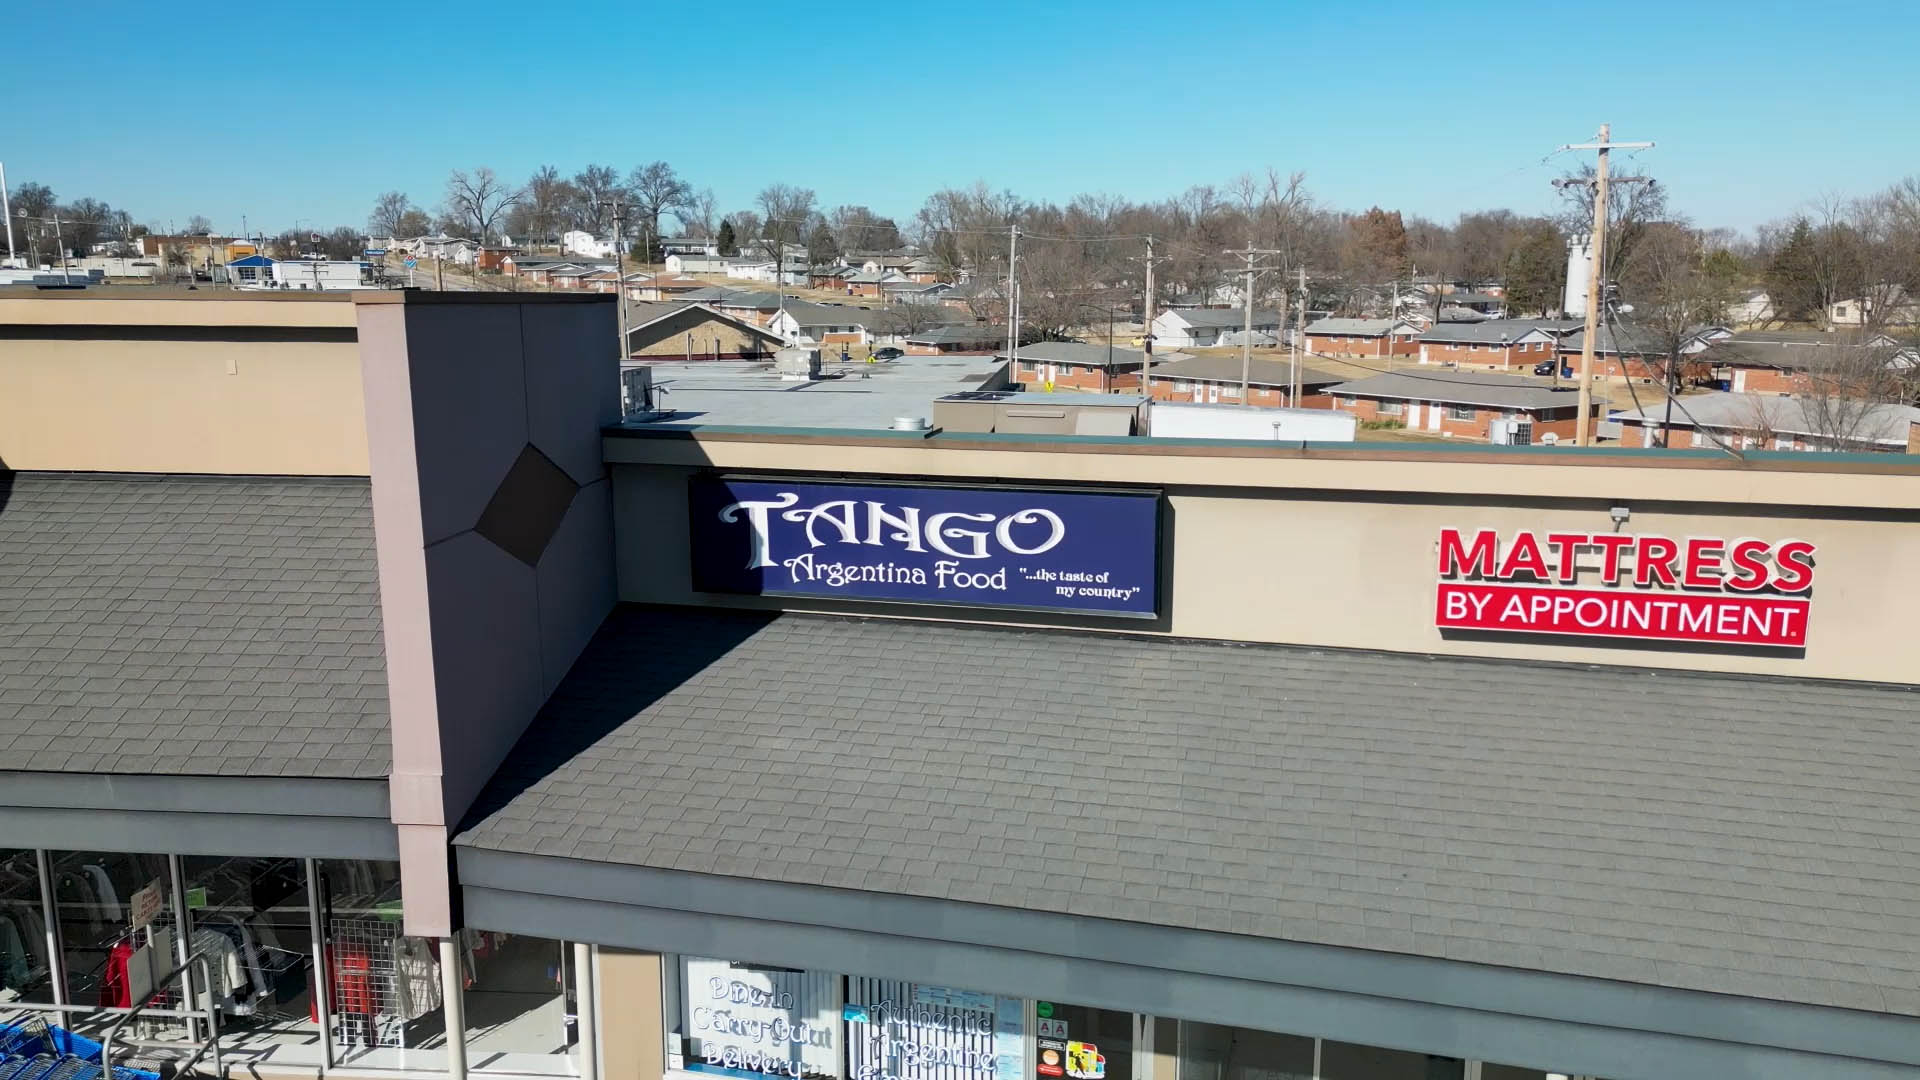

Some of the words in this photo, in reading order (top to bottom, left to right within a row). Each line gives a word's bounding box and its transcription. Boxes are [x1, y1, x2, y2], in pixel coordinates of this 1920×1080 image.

[719, 492, 1066, 569] TANGO
[783, 553, 927, 587] Argentina
[934, 560, 1007, 591] Food
[1059, 568, 1094, 583] taste
[1095, 572, 1110, 584] of
[1438, 527, 1816, 592] MATTRESS
[1055, 585, 1075, 598] my
[1446, 591, 1493, 621] BY
[693, 1006, 812, 1043] Carry-Out
[870, 999, 993, 1036] Authentic
[704, 1041, 802, 1080] Delivery
